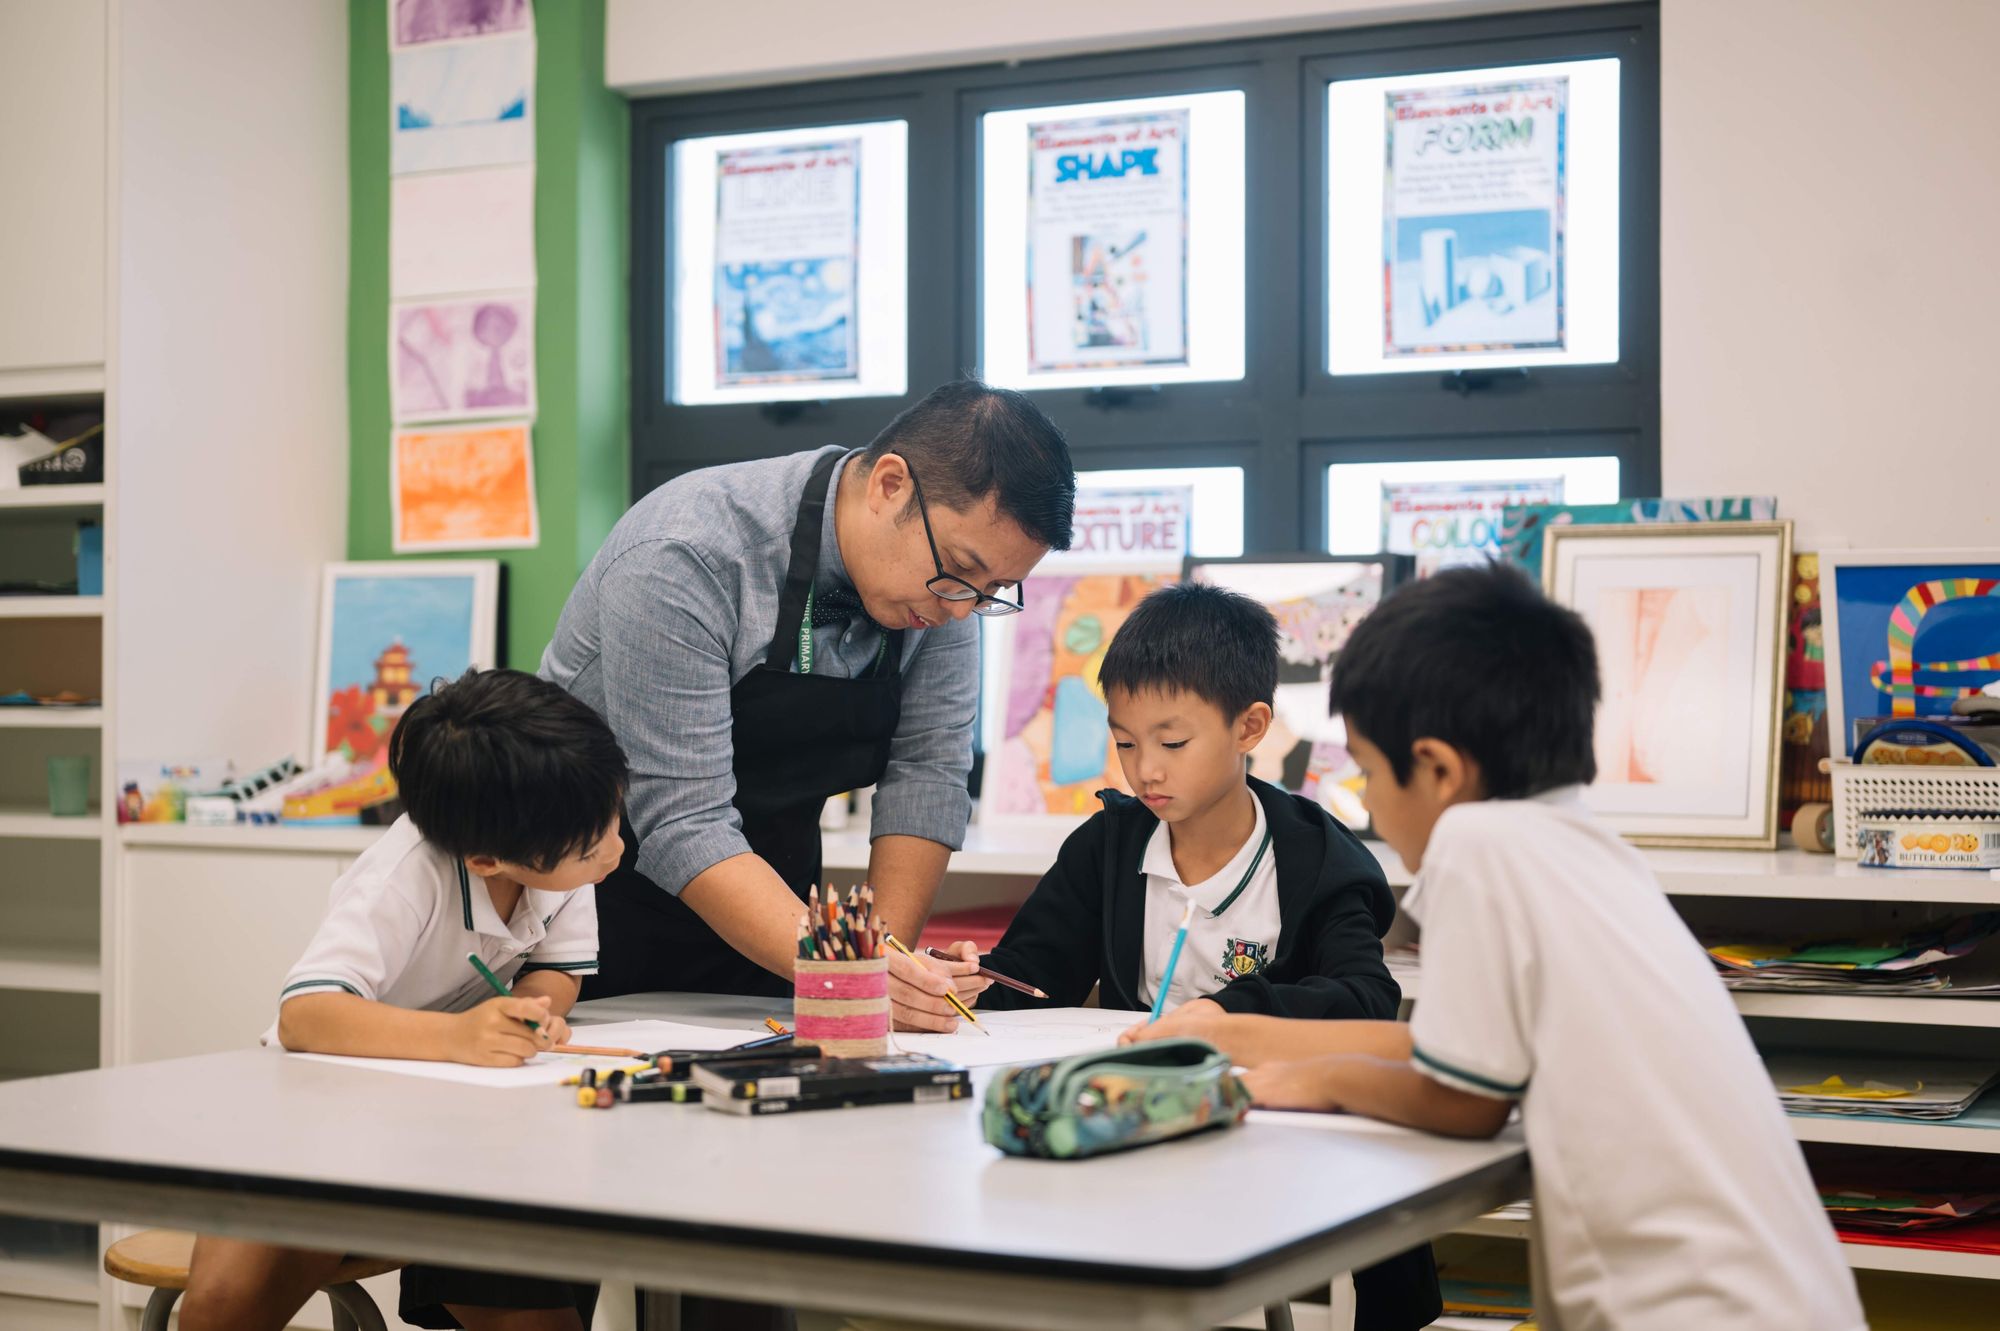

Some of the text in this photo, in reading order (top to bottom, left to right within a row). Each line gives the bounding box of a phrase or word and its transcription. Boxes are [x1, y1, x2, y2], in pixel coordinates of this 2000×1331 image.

[1396, 104, 1486, 120] Elements
[1522, 96, 1553, 110] Art
[1415, 116, 1534, 156] FORM
[1056, 147, 1159, 183] SHAPE
[1412, 518, 1502, 548] COLOU
[1899, 853, 1936, 862] BUTTER
[1938, 853, 1980, 863] COOKIES
